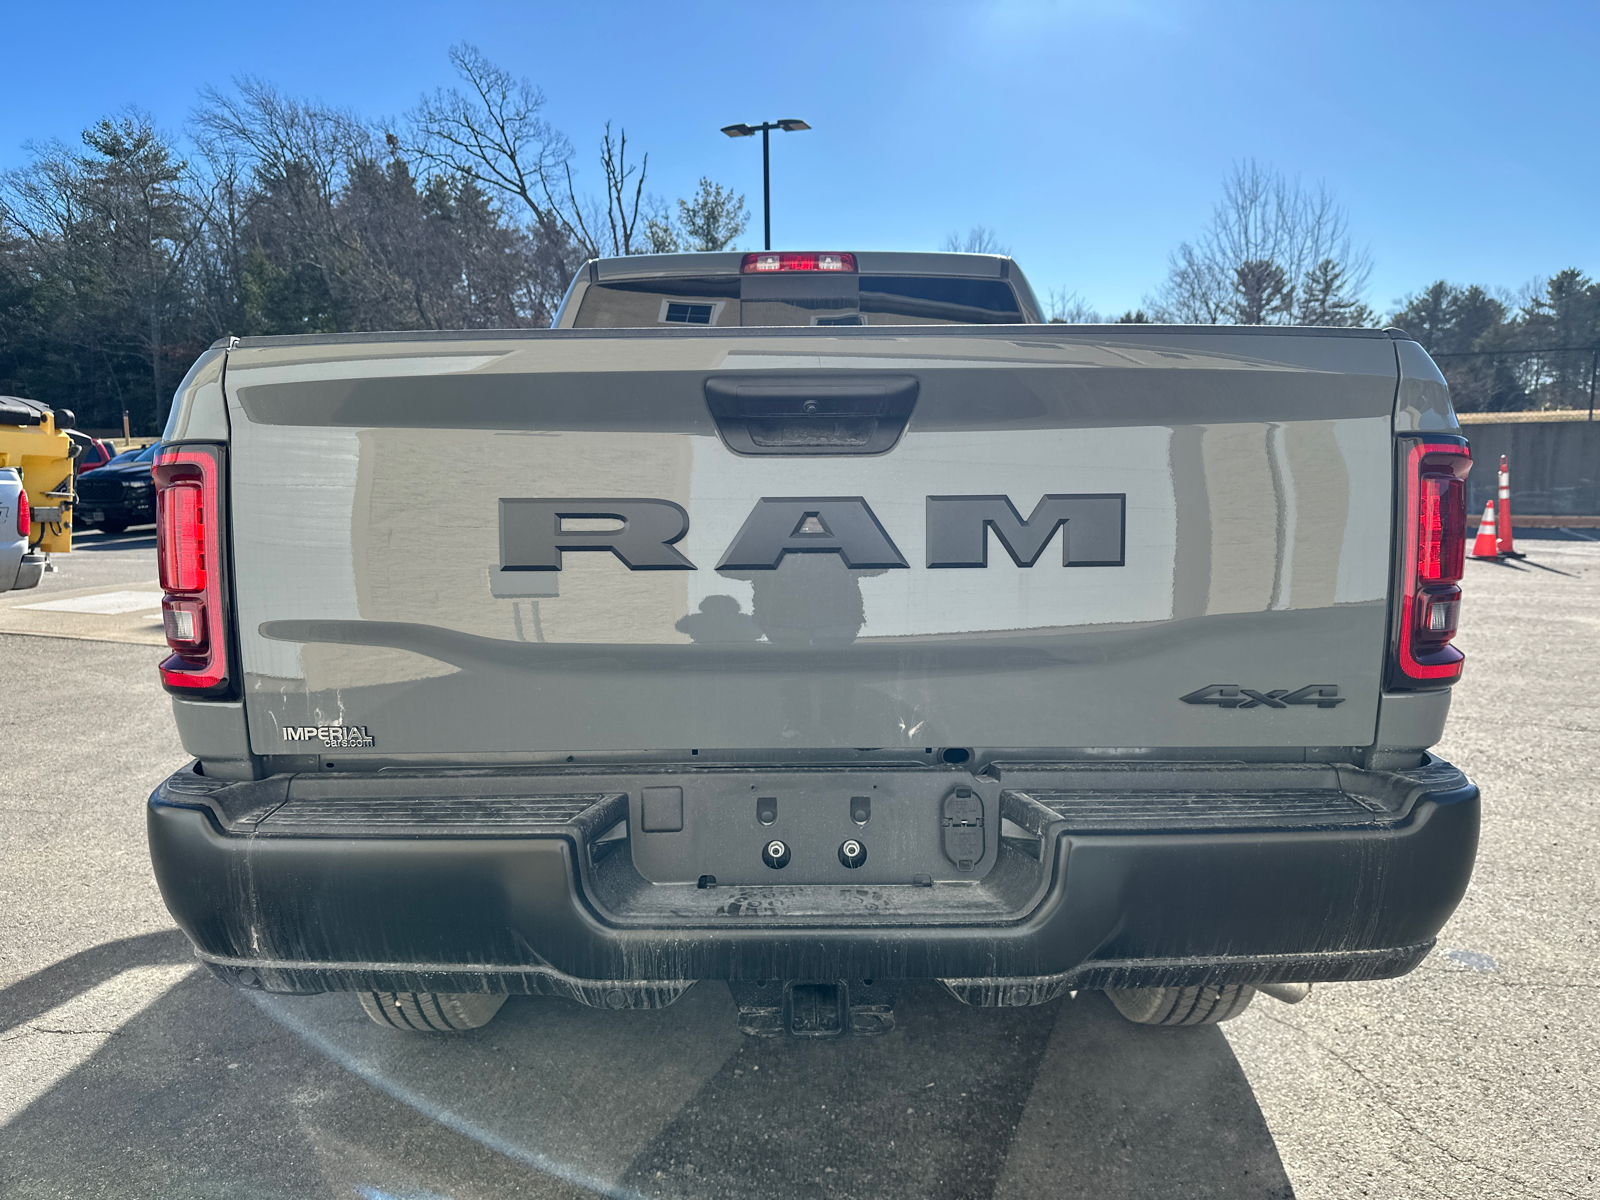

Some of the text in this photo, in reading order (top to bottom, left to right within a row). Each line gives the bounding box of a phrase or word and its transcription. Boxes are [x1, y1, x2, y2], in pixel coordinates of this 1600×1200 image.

[498, 493, 1127, 571] RAM
[1179, 684, 1346, 708] 4x4
[282, 726, 375, 741] IMPERIAL
[323, 738, 376, 748] cars.com
